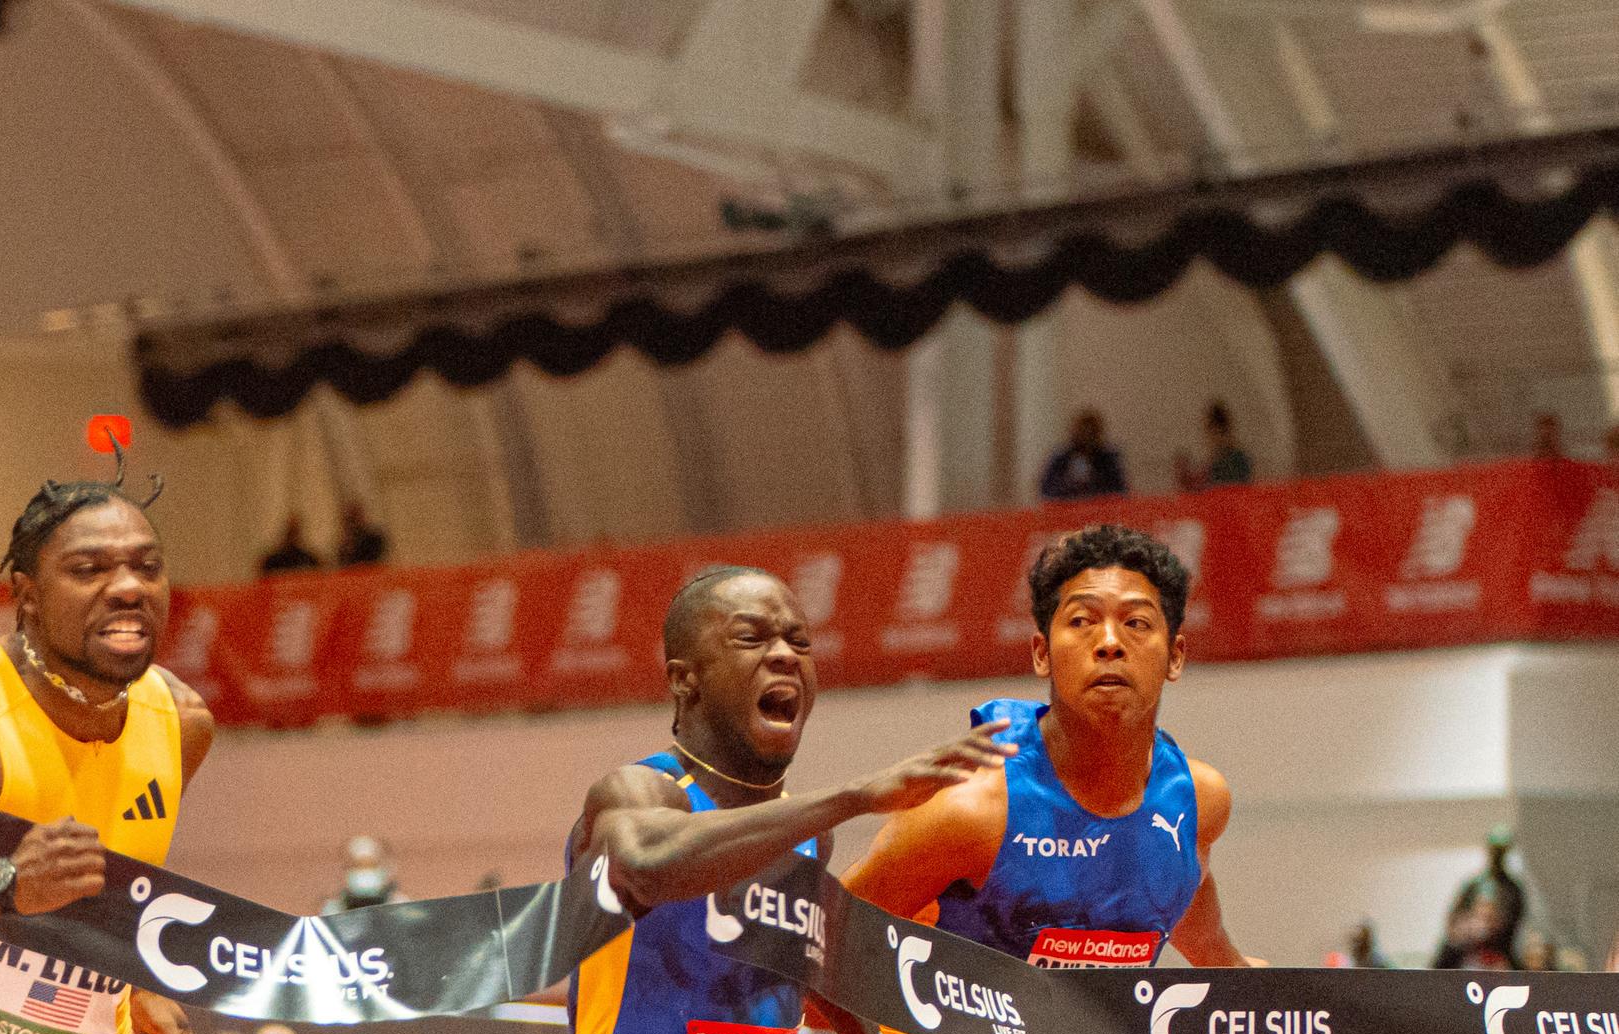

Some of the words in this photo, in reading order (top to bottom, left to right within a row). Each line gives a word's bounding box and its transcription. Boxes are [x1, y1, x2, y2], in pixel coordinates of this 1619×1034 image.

[1042, 937, 1082, 955] new
[1083, 938, 1150, 958] balance
[934, 970, 1023, 1027] CELSIUS
